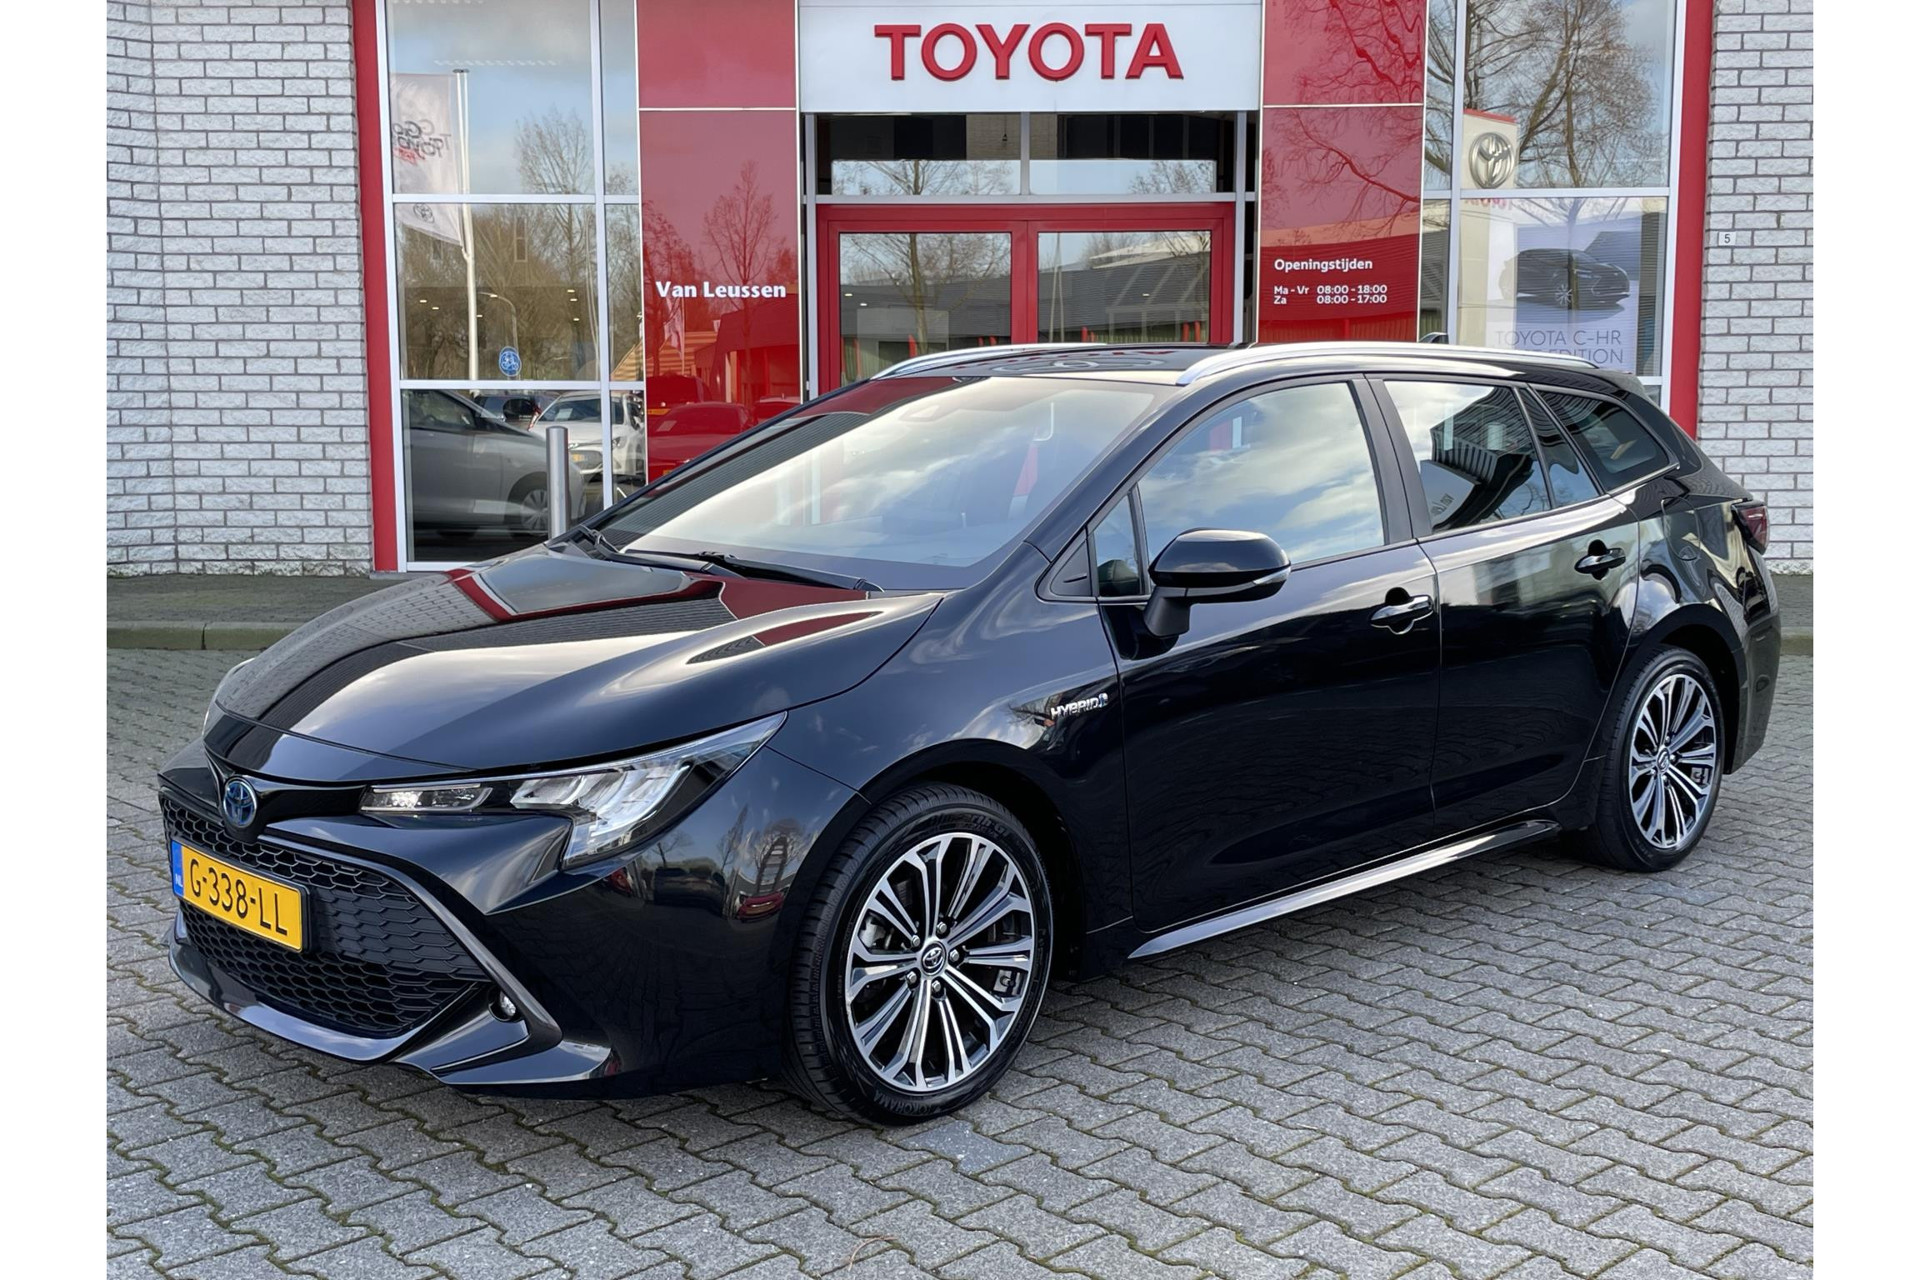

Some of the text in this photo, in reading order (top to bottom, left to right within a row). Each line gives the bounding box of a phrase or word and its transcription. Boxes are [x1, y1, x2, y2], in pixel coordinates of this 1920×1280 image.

[874, 22, 1184, 82] TOYOTA
[1724, 233, 1731, 244] 5
[1274, 258, 1373, 273] Openingstijden
[656, 281, 787, 298] Van Leussen
[1274, 286, 1289, 295] Ma
[1297, 286, 1309, 295] Vr
[1317, 285, 1349, 295] 08:00
[1357, 284, 1388, 294] 18:00
[1273, 295, 1287, 305] Za
[1316, 295, 1349, 304] 08:00
[1357, 294, 1388, 304] 17:00
[1496, 330, 1622, 346] TOYOTA C-HR
[1050, 696, 1100, 719] HYBRID
[190, 858, 288, 936] G-338-LL
